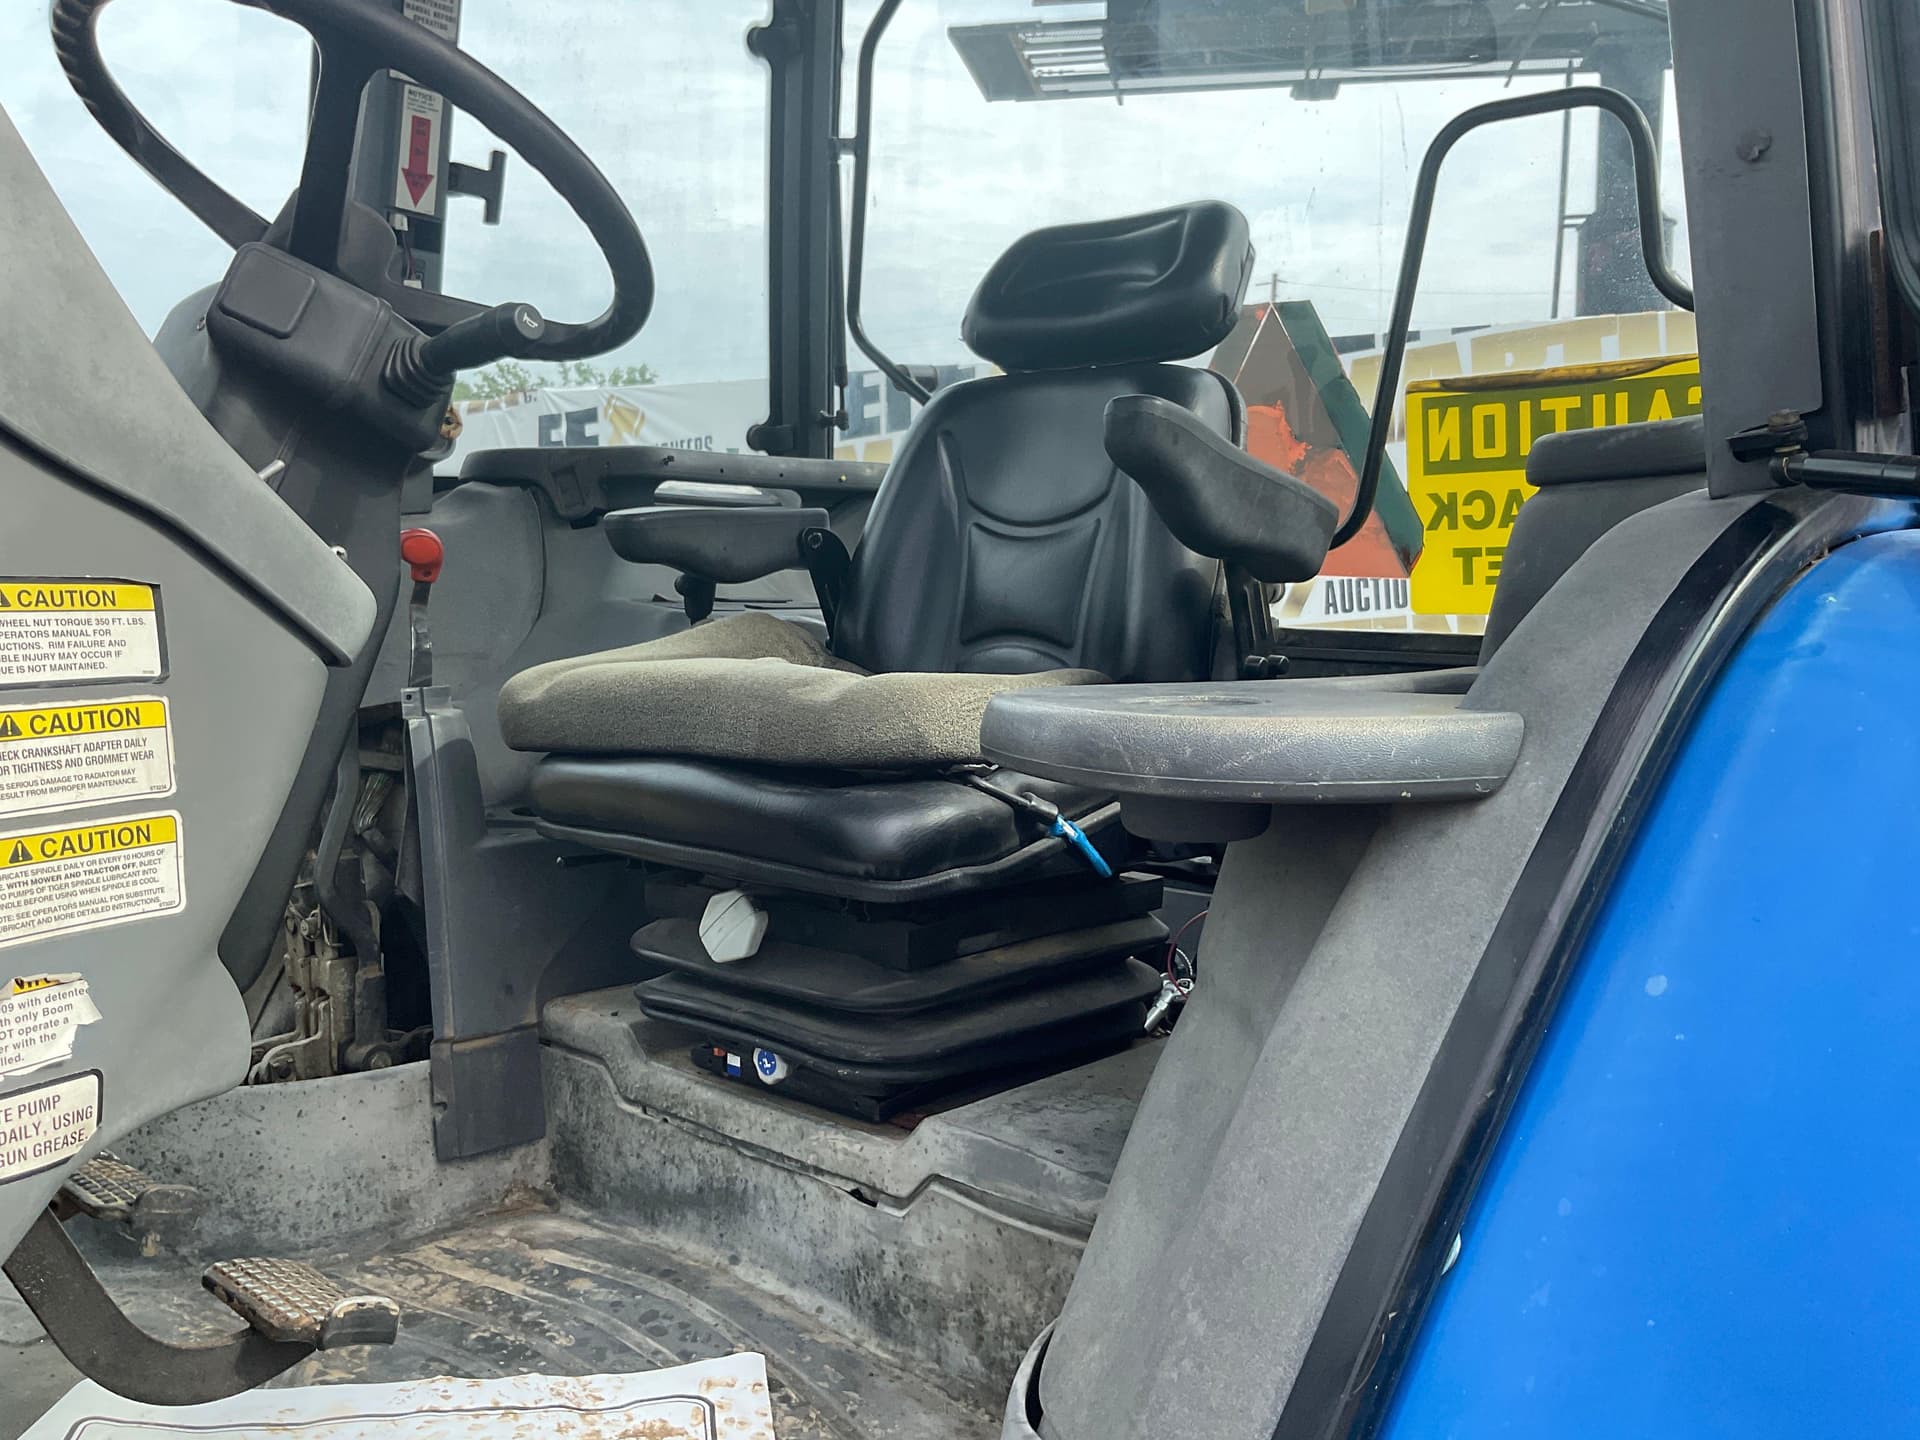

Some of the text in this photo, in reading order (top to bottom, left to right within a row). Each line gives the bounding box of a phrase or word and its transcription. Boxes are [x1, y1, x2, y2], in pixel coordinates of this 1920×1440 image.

[17, 590, 116, 608] CAUTION
[0, 618, 31, 628] WHEEL
[33, 618, 52, 626] NUT
[54, 618, 93, 626] TORQUE
[94, 618, 110, 626] 350
[48, 641, 65, 649] RIM
[68, 640, 105, 649] FAILURE
[52, 630, 91, 638] MANUAL
[0, 654, 20, 662] BLE
[22, 652, 56, 661] INJURY
[58, 652, 78, 660] MAY
[80, 651, 112, 659] OCCUR
[0, 661, 108, 674] UE IS NOT MAINTAINED.
[30, 706, 140, 734] CAUTION
[22, 744, 81, 760] CRANKSHAFT
[84, 740, 122, 753] ADAPTER
[124, 737, 147, 748] DAILY
[12, 759, 62, 775] TIGHTNESS
[65, 757, 83, 768] AND
[85, 752, 128, 766] GROMMET
[130, 750, 154, 761] WEAR
[6, 780, 39, 790] SERIOUS
[40, 776, 72, 785] DAMAGE
[84, 770, 120, 780] RADIATOR
[0, 791, 24, 800] ESULT
[26, 788, 48, 797] FROM
[49, 783, 86, 794] IMPROPER
[40, 824, 151, 858] CAUTION
[0, 871, 30, 881] RICATE
[30, 864, 62, 875] SPINDLE
[64, 860, 85, 870] DAILY
[86, 859, 97, 867] OR
[98, 855, 122, 865] EVERY
[132, 850, 155, 859] HOURS
[7, 880, 28, 890] WITH
[30, 874, 62, 885] MOWER
[64, 871, 81, 880] AND
[82, 864, 120, 876] TRACTOR
[139, 858, 162, 867] INJECT
[8, 888, 35, 899] PUMPS
[48, 882, 70, 892] TIGER
[71, 876, 101, 887] SPINDLE
[102, 870, 141, 882] LUBRICANT
[142, 867, 158, 876] INTO
[24, 894, 54, 905] BEFORE
[55, 890, 78, 900] USING
[79, 886, 100, 896] WHEN
[102, 881, 131, 891] SPINDLE
[16, 911, 31, 920] SEE
[32, 902, 78, 916] OPERATORS
[79, 897, 109, 908] MANUAL
[110, 894, 124, 902] FOR
[125, 886, 165, 899] SUBSTITUTE
[37, 916, 52, 926] AND
[54, 912, 76, 921] MORE
[77, 905, 111, 917] DETAILED
[1, 1003, 14, 1014] 09
[18, 998, 41, 1010] with
[14, 1012, 38, 1024] only
[42, 1003, 73, 1016] Boom
[18, 1019, 60, 1036] operate
[13, 1038, 36, 1050] with
[40, 1032, 57, 1043] the
[18, 1094, 61, 1119] PUMP
[53, 1105, 93, 1130] USING
[33, 1128, 88, 1158] GREASE.
